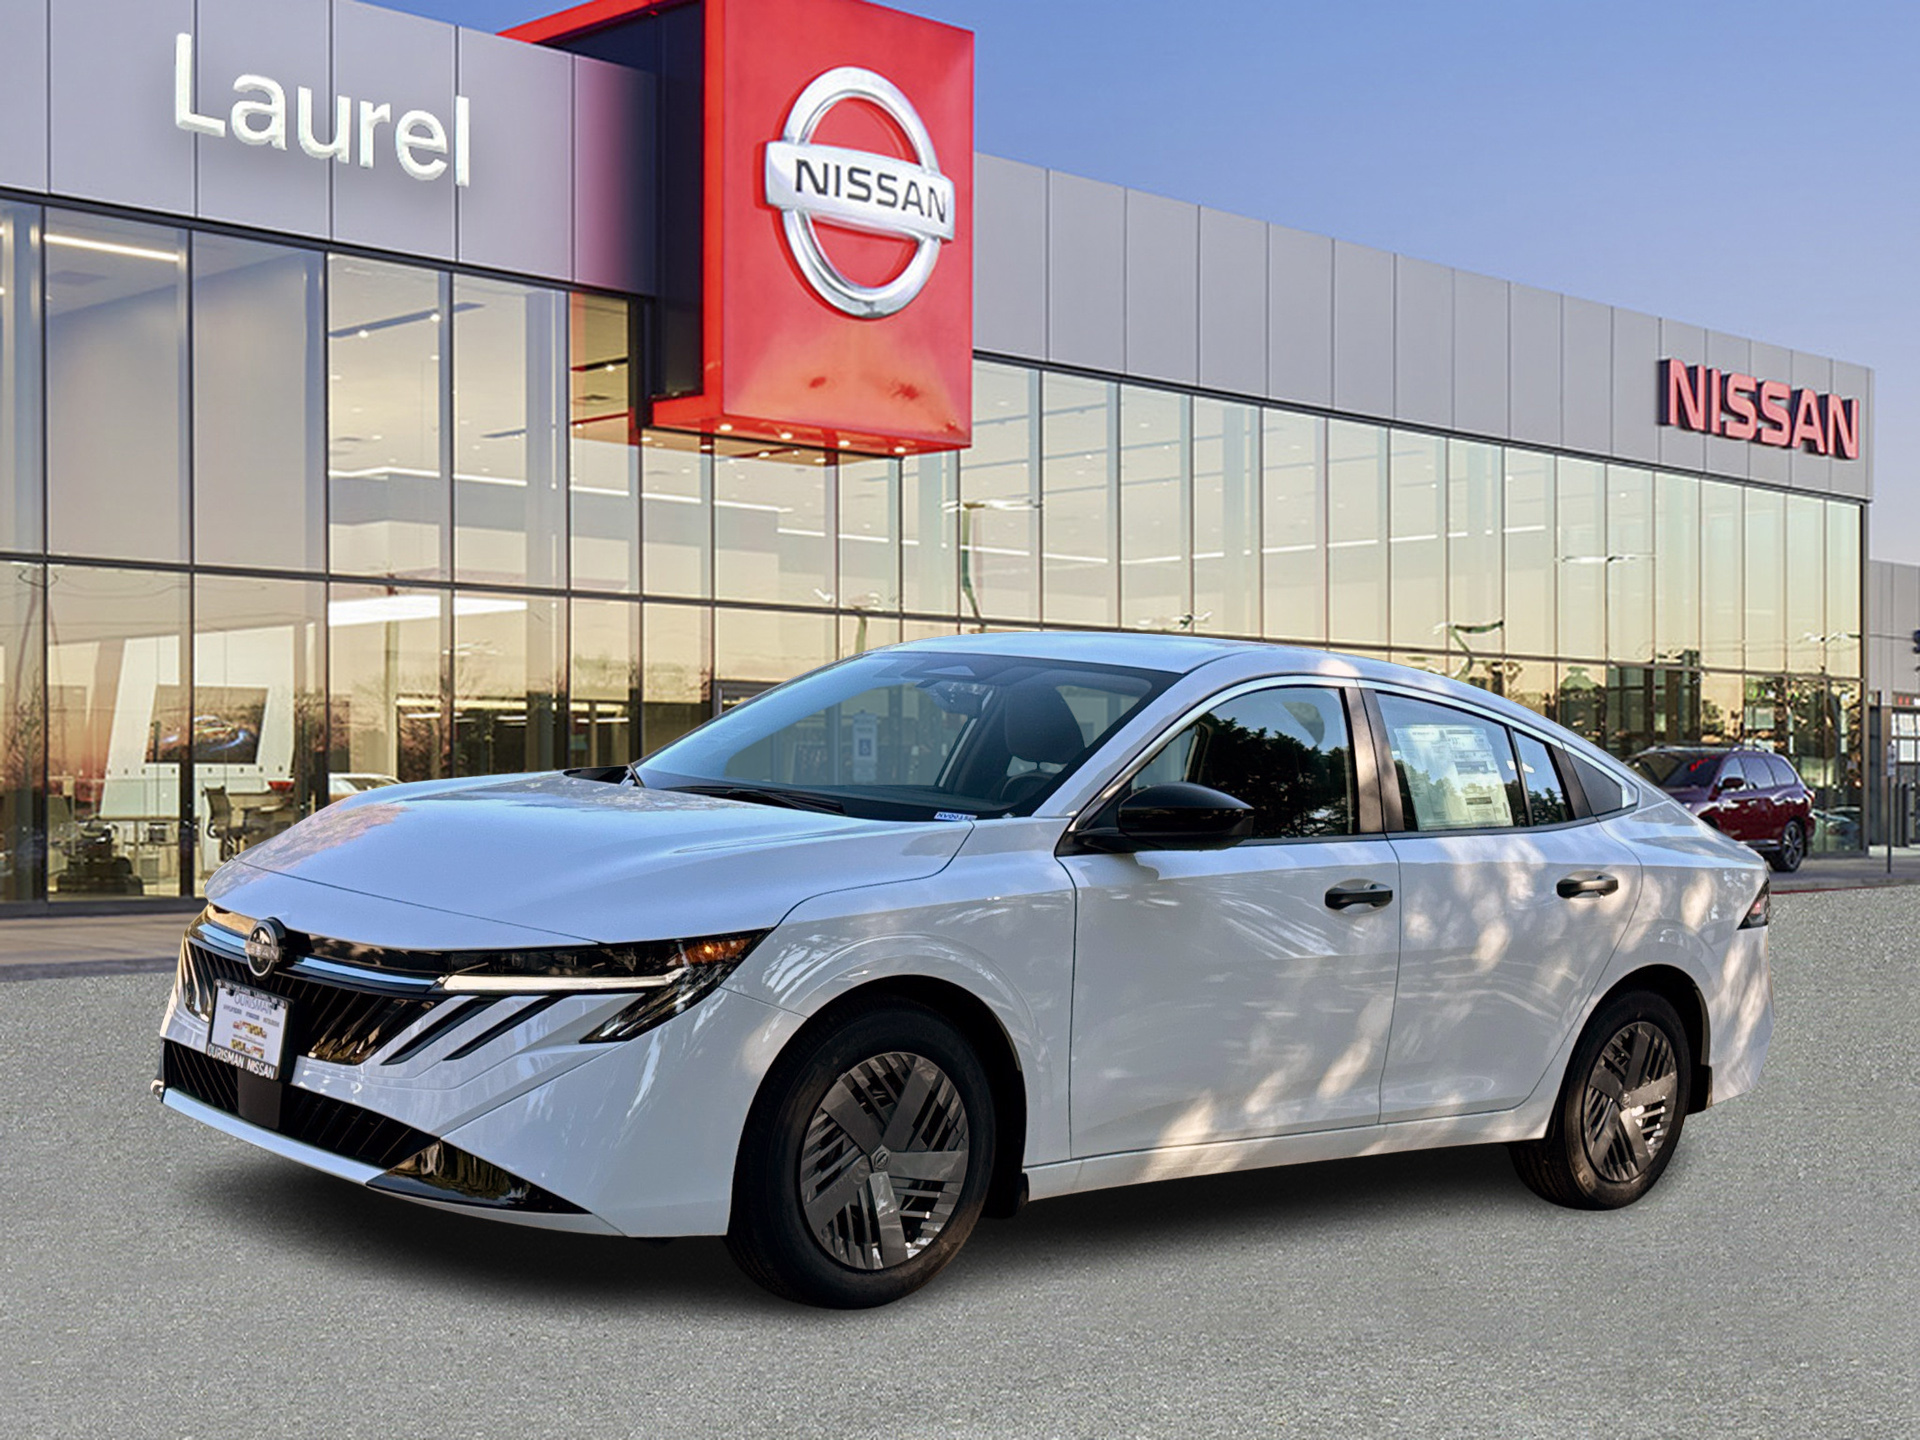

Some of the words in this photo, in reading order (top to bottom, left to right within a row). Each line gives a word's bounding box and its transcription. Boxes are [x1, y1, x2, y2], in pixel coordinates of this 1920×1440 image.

[175, 33, 470, 187] Laurel
[795, 158, 946, 223] NISSAN
[1658, 358, 1859, 459] NISSAN
[206, 1044, 245, 1069] OURISMAN
[246, 1058, 275, 1080] NISSAN
